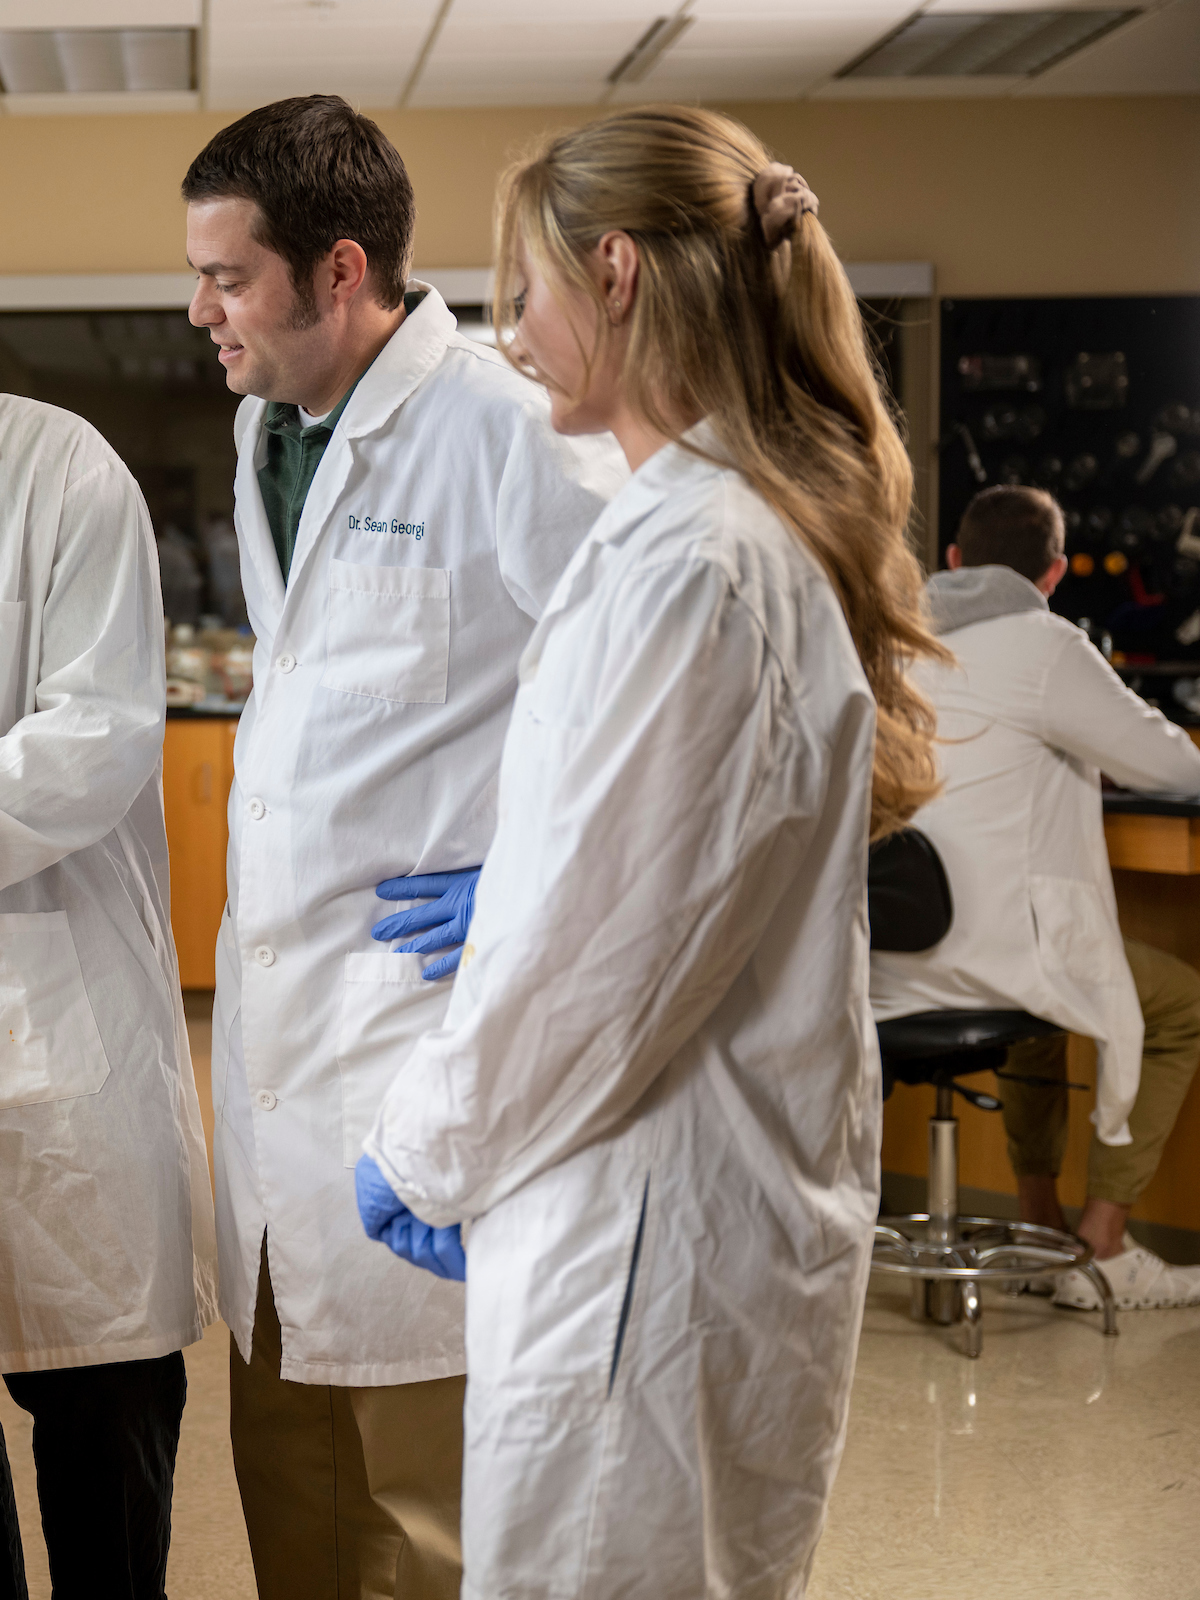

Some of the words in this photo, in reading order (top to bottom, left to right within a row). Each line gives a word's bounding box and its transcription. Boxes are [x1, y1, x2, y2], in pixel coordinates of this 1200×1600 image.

[349, 515, 361, 530] Dr.
[364, 516, 388, 533] Sean
[391, 518, 425, 541] Georgi
